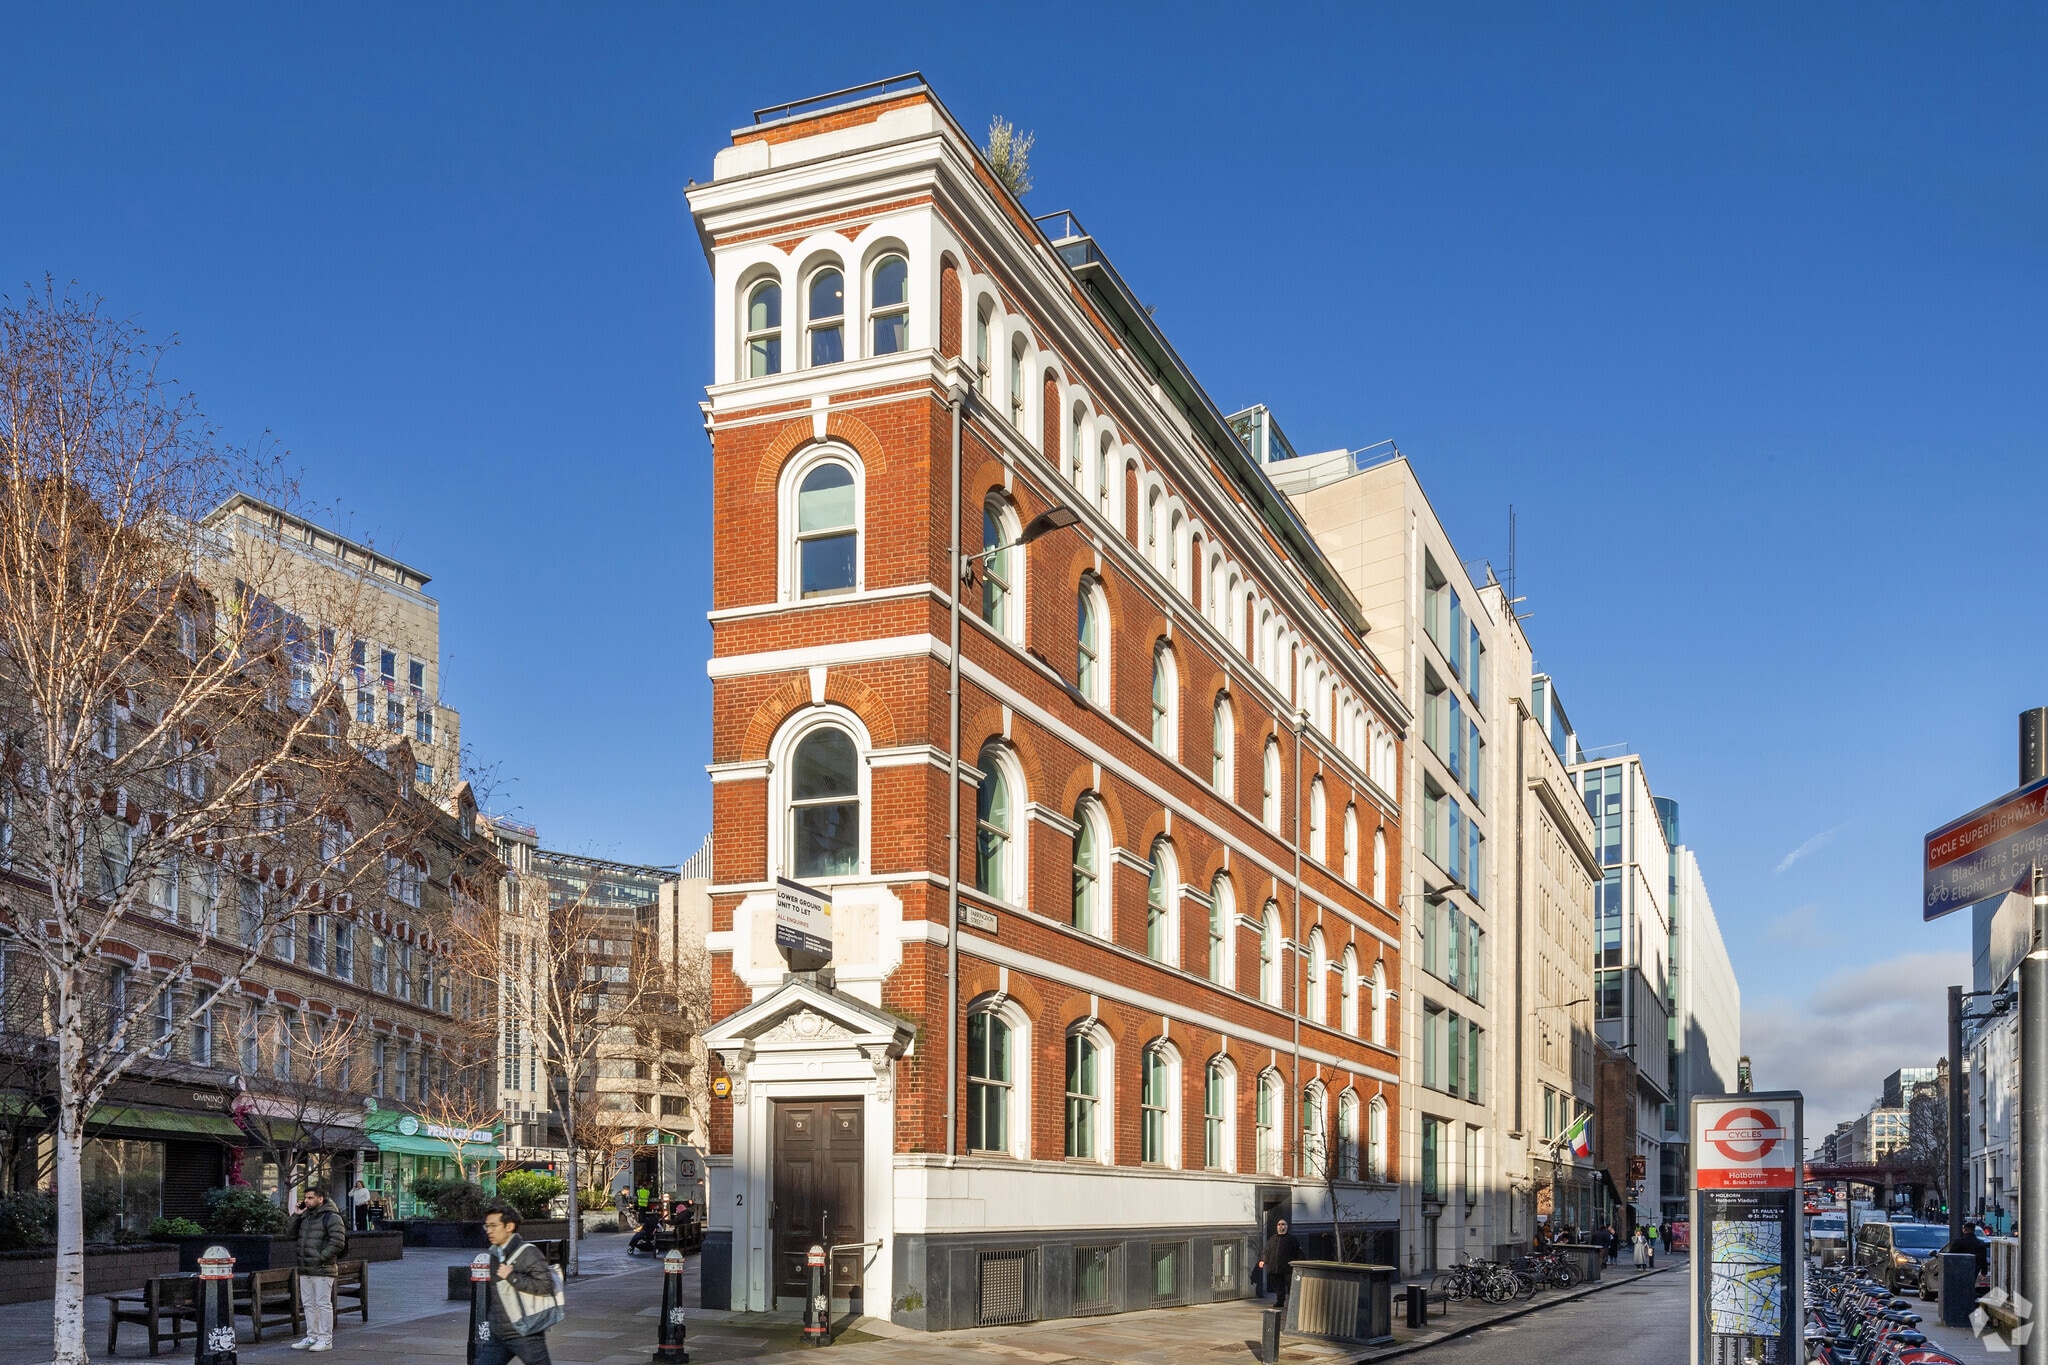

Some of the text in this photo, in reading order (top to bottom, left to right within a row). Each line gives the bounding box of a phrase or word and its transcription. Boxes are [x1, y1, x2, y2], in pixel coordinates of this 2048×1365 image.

[1930, 800, 2037, 860] CYCLE SUPERHIGHWAY
[1952, 834, 2048, 883] Blackfriars Bridge
[1951, 872, 1996, 901] Elephant
[2000, 867, 2007, 881] &
[777, 890, 822, 912] LOWER GROUND
[777, 899, 811, 916] UNIT TO LET
[777, 913, 809, 928] ALL ENQUIRIES
[970, 917, 984, 926] STREET
[192, 1092, 224, 1104] OMNINO
[1728, 1130, 1762, 1139] CYCLES
[736, 1194, 743, 1206] 2
